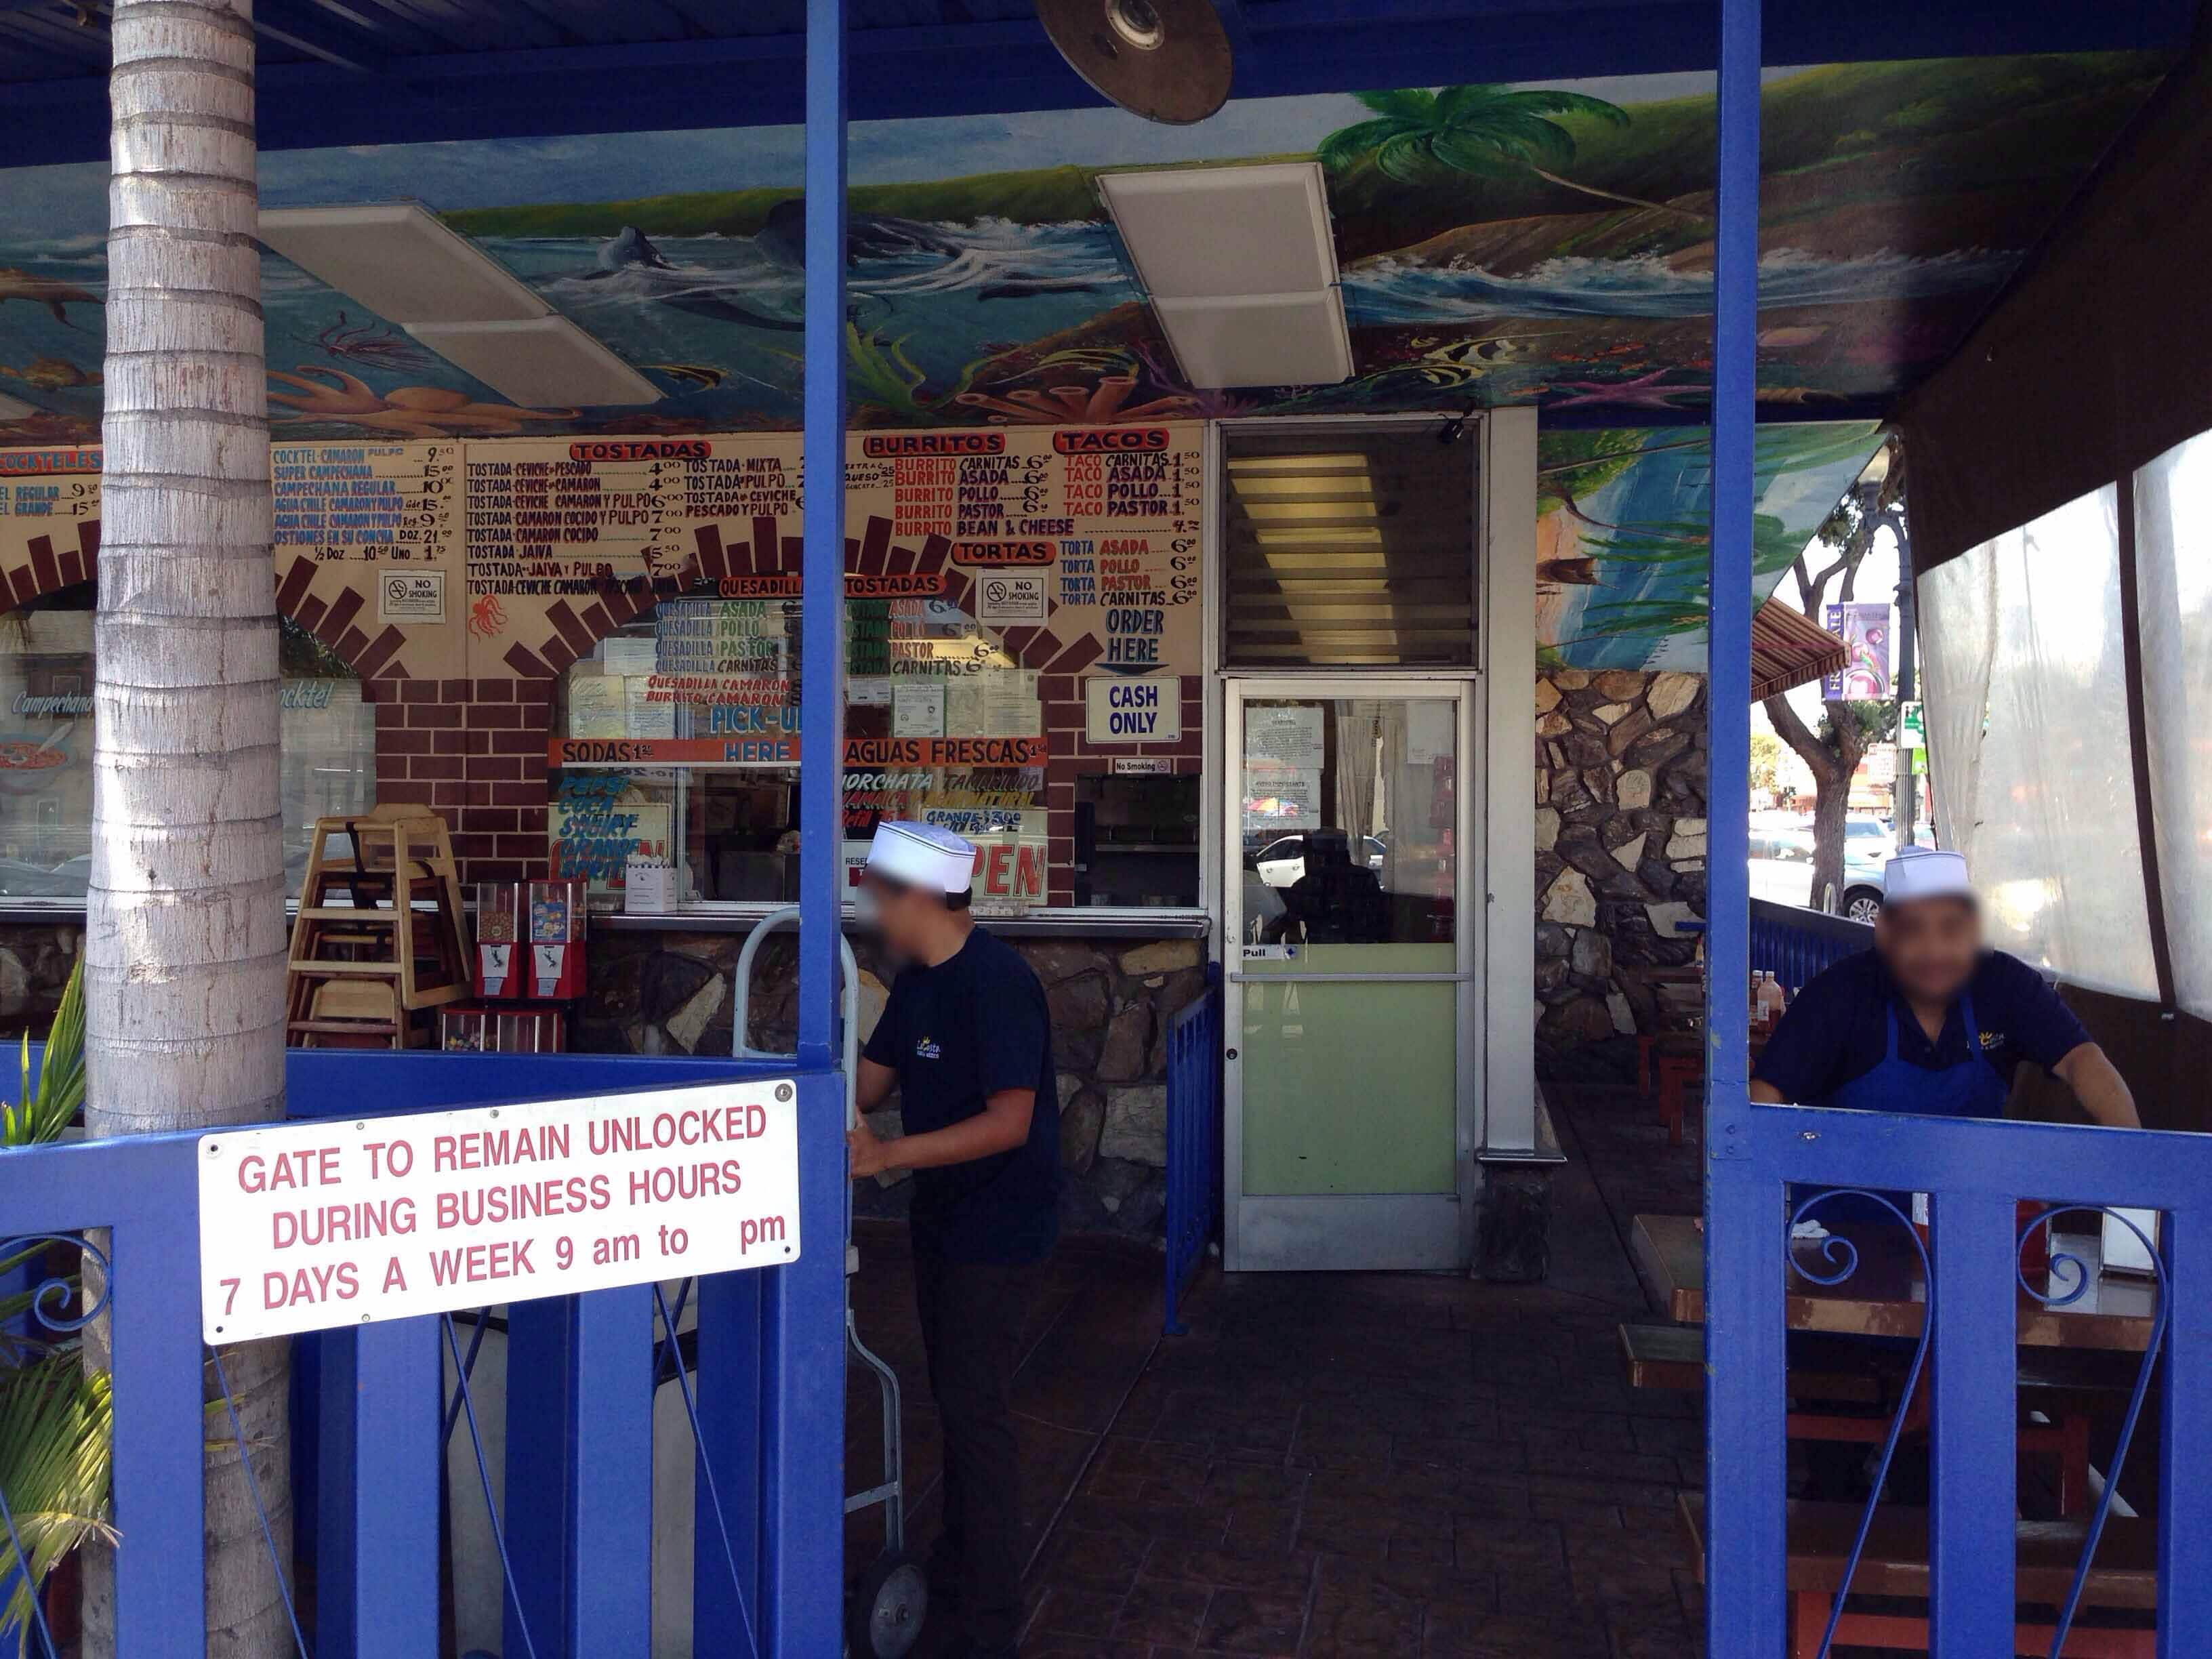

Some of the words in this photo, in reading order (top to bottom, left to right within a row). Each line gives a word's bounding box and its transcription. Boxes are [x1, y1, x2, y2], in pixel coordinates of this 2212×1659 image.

[870, 434, 1002, 453] BURRITOS
[1062, 431, 1164, 451] TACOS
[575, 443, 705, 459] TOSTADAS
[684, 459, 740, 472] TOSTADA
[746, 458, 781, 472] MIXTA
[895, 458, 956, 470] BURRITO
[959, 455, 1020, 470] CARNITAS
[1065, 455, 1102, 466] TACO
[1105, 452, 1169, 467] CARNITAS
[555, 462, 592, 476] PESCADO
[1065, 467, 1102, 482] TACO
[1107, 466, 1166, 483] ASADA
[554, 477, 600, 493] CAMARON
[684, 476, 740, 491] TOSTADA
[746, 474, 785, 489] PULPO
[895, 470, 955, 486] BURRITO
[959, 470, 1009, 485] ASADA
[274, 481, 348, 496] CAMPECHANA
[351, 480, 395, 496] REGULAR
[895, 488, 954, 502] BURRITO
[958, 487, 998, 502] POLLO
[1064, 484, 1103, 499] TACO
[1107, 483, 1158, 499] POLLO
[555, 493, 601, 508] CAMARON
[613, 493, 651, 508] PULPO
[684, 491, 739, 504] TOSTADA
[750, 489, 796, 502] CEVICHE
[686, 504, 739, 518] PESCADO
[750, 502, 787, 516] PULPO
[895, 504, 952, 519] BURRITO
[958, 504, 1004, 519] PASTOR
[1064, 501, 1103, 516] TACO
[1107, 499, 1168, 516] PASTOR
[565, 510, 598, 525] COCIDO
[611, 510, 649, 525] PULPO
[564, 527, 598, 542] COCIDO
[895, 521, 951, 536] BURRITO
[956, 520, 998, 536] BEAN
[1006, 521, 1015, 536] &
[1019, 519, 1074, 536] CHEESE
[467, 546, 514, 559] TOSTADA
[519, 544, 552, 559] JAIVA
[959, 543, 1046, 560] TORTAS
[1060, 541, 1094, 555] TORTA
[1100, 539, 1149, 555] ASADA
[528, 562, 562, 577] JAIVA
[1060, 559, 1094, 574] TORTA
[1100, 558, 1140, 575] POLLO
[415, 580, 431, 588] NO
[845, 577, 939, 594] TOSTADAS
[1016, 582, 1032, 590] NO
[1060, 577, 1095, 592] TORTA
[1101, 575, 1151, 592] PASTOR
[1008, 592, 1039, 600] SMOKING
[1060, 593, 1096, 605] TORTA
[1100, 591, 1166, 607] CARNITAS
[1106, 609, 1164, 635] ORDER
[891, 642, 934, 659] PASTOR
[1107, 637, 1159, 663] HERE
[892, 660, 962, 677] CARNITAS
[648, 675, 717, 690] QUESADILLA
[1109, 685, 1158, 708] CASH
[1109, 712, 1158, 734] ONLY
[563, 743, 630, 762] SODAS
[724, 741, 790, 763] HERE
[844, 741, 920, 763] AGUAS
[930, 739, 1029, 764] FRESCAS
[1127, 762, 1155, 771] Smoking
[239, 1147, 340, 1193] GATE
[364, 1140, 413, 1177] TO
[434, 1124, 570, 1172] REMAIN
[588, 1105, 767, 1155] UNLOCKED
[273, 1197, 416, 1249] DURING
[437, 1174, 611, 1229] BUSINESS
[629, 1159, 741, 1205] HOURS
[220, 1277, 241, 1315] 7
[264, 1262, 359, 1309] DAYS
[383, 1256, 407, 1294] A
[430, 1239, 535, 1286] WEEK
[556, 1235, 574, 1270] 9
[593, 1233, 639, 1265] am
[659, 1224, 689, 1256] to
[740, 1214, 785, 1254] pm
